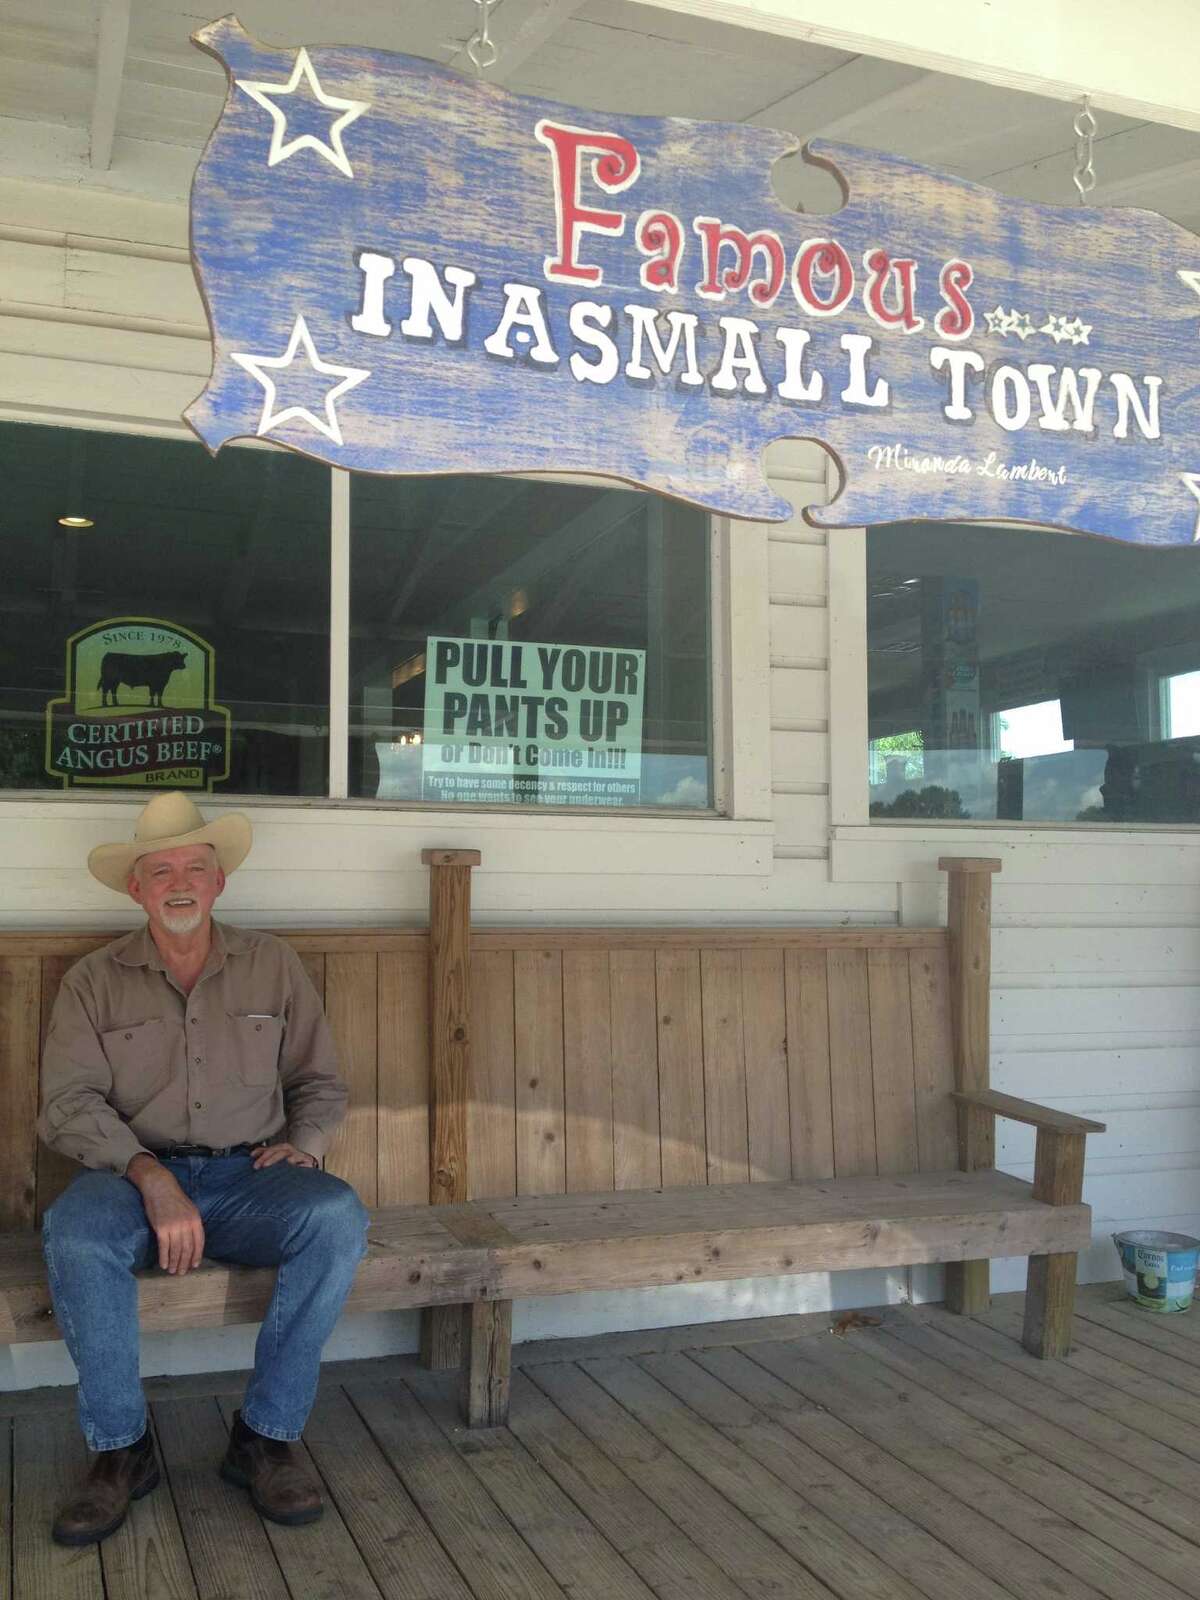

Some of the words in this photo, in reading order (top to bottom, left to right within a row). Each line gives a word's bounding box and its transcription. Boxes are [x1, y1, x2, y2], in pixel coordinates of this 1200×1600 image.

[535, 118, 977, 342] Famous
[351, 252, 477, 342] IN
[569, 302, 889, 408] SMALL
[930, 346, 1163, 440] TOWN
[867, 443, 973, 474] Miranda
[976, 451, 1067, 485] Lambert
[150, 632, 183, 649] 1978
[434, 641, 528, 689] PULL
[537, 647, 640, 695] YOUR
[67, 715, 205, 745] CERTIFIED
[442, 691, 569, 741] PANTS
[579, 698, 630, 743] UP
[56, 746, 149, 769] ANGUS
[525, 744, 583, 769] Come
[145, 768, 200, 783] BRAND
[428, 775, 443, 789] Try
[445, 776, 455, 788] to
[456, 776, 480, 789] have
[481, 778, 507, 790] some
[557, 780, 592, 793] respect
[592, 781, 607, 793] for
[607, 781, 636, 794] others
